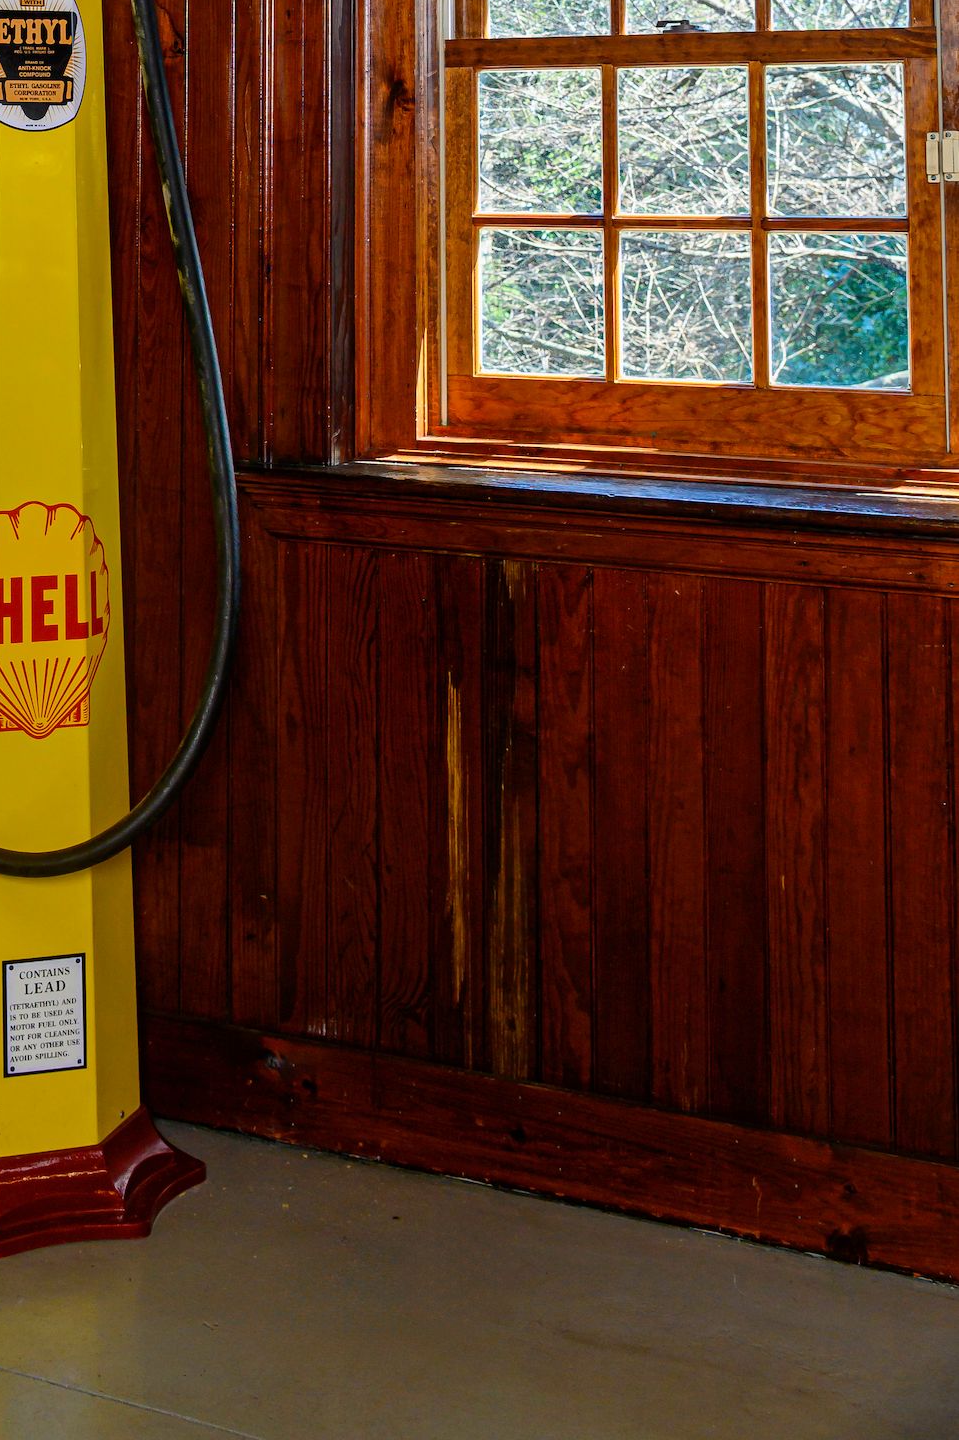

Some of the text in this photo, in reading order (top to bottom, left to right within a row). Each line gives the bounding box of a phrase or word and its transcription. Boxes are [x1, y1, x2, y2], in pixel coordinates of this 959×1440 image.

[19, 966, 70, 980] CONTAINS
[24, 980, 66, 995] LEAD
[10, 997, 77, 1011] (TETRAETHYL) AND
[44, 1010, 62, 1018] USED
[10, 1023, 35, 1032] MOTOR
[38, 1020, 56, 1029] FUEL
[44, 1028, 80, 1038] CLEANING
[23, 1043, 37, 1051] ANY
[40, 1040, 64, 1049] OTHER
[10, 1050, 70, 1063] AVOID SPILLING.
